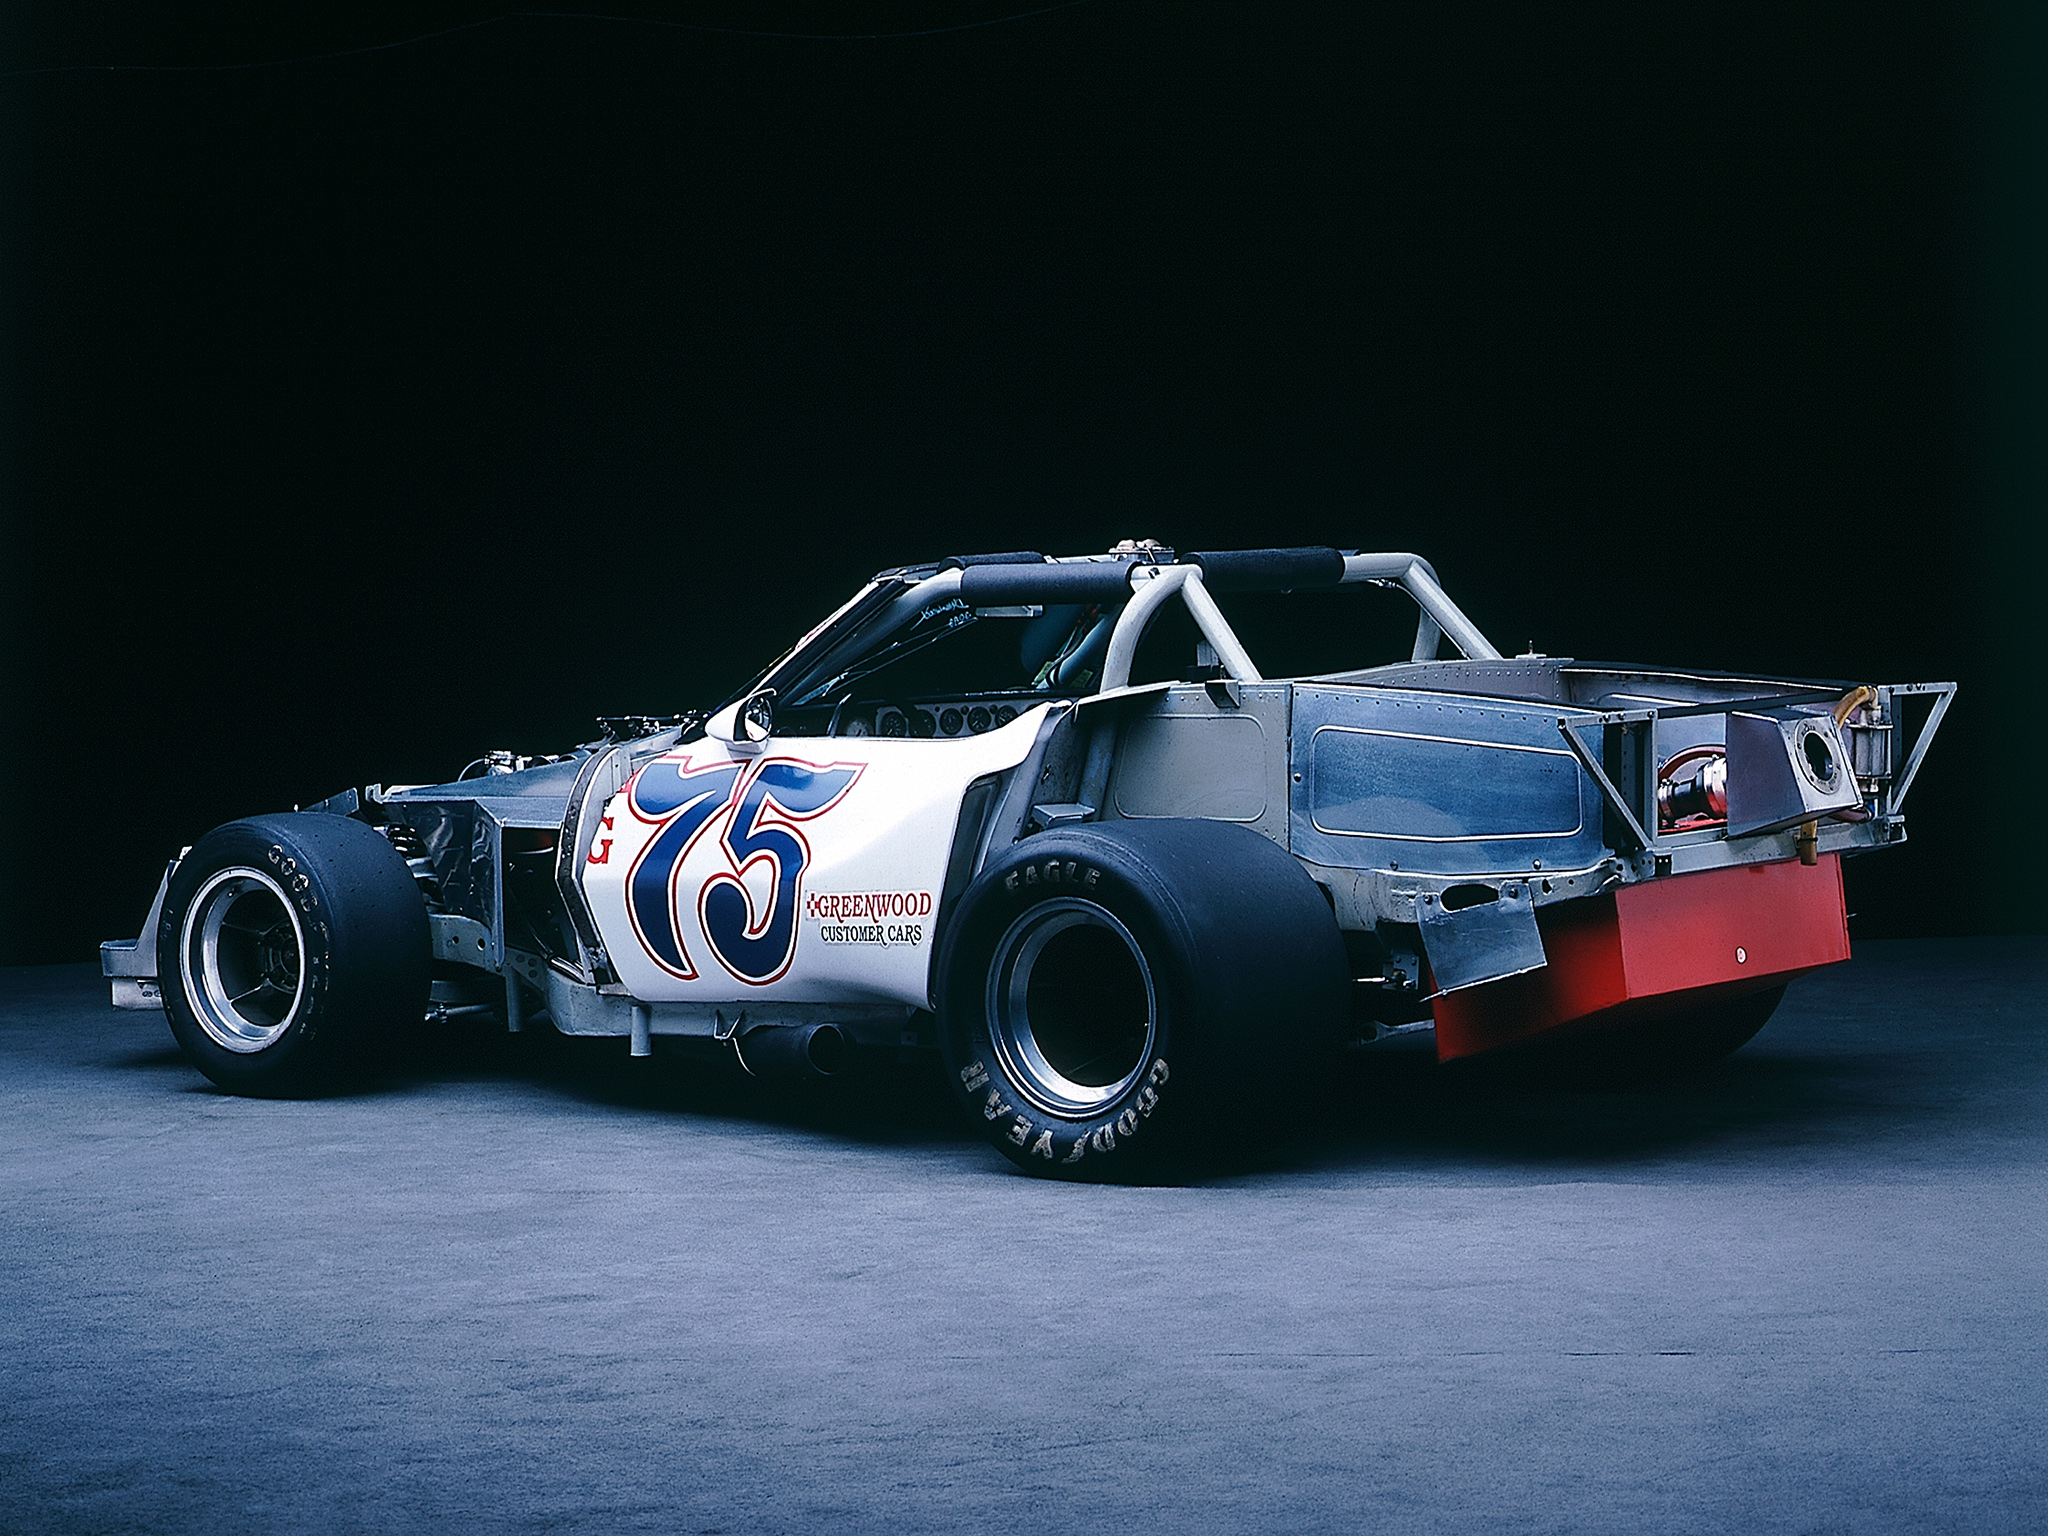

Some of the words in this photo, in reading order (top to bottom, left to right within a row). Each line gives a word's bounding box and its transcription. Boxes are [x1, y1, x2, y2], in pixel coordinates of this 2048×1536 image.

[625, 756, 868, 986] 75
[1006, 859, 1101, 891] EAGLE
[819, 893, 931, 923] GREENWOOD
[821, 925, 887, 946] CUSTOMER
[888, 925, 922, 946] CARS
